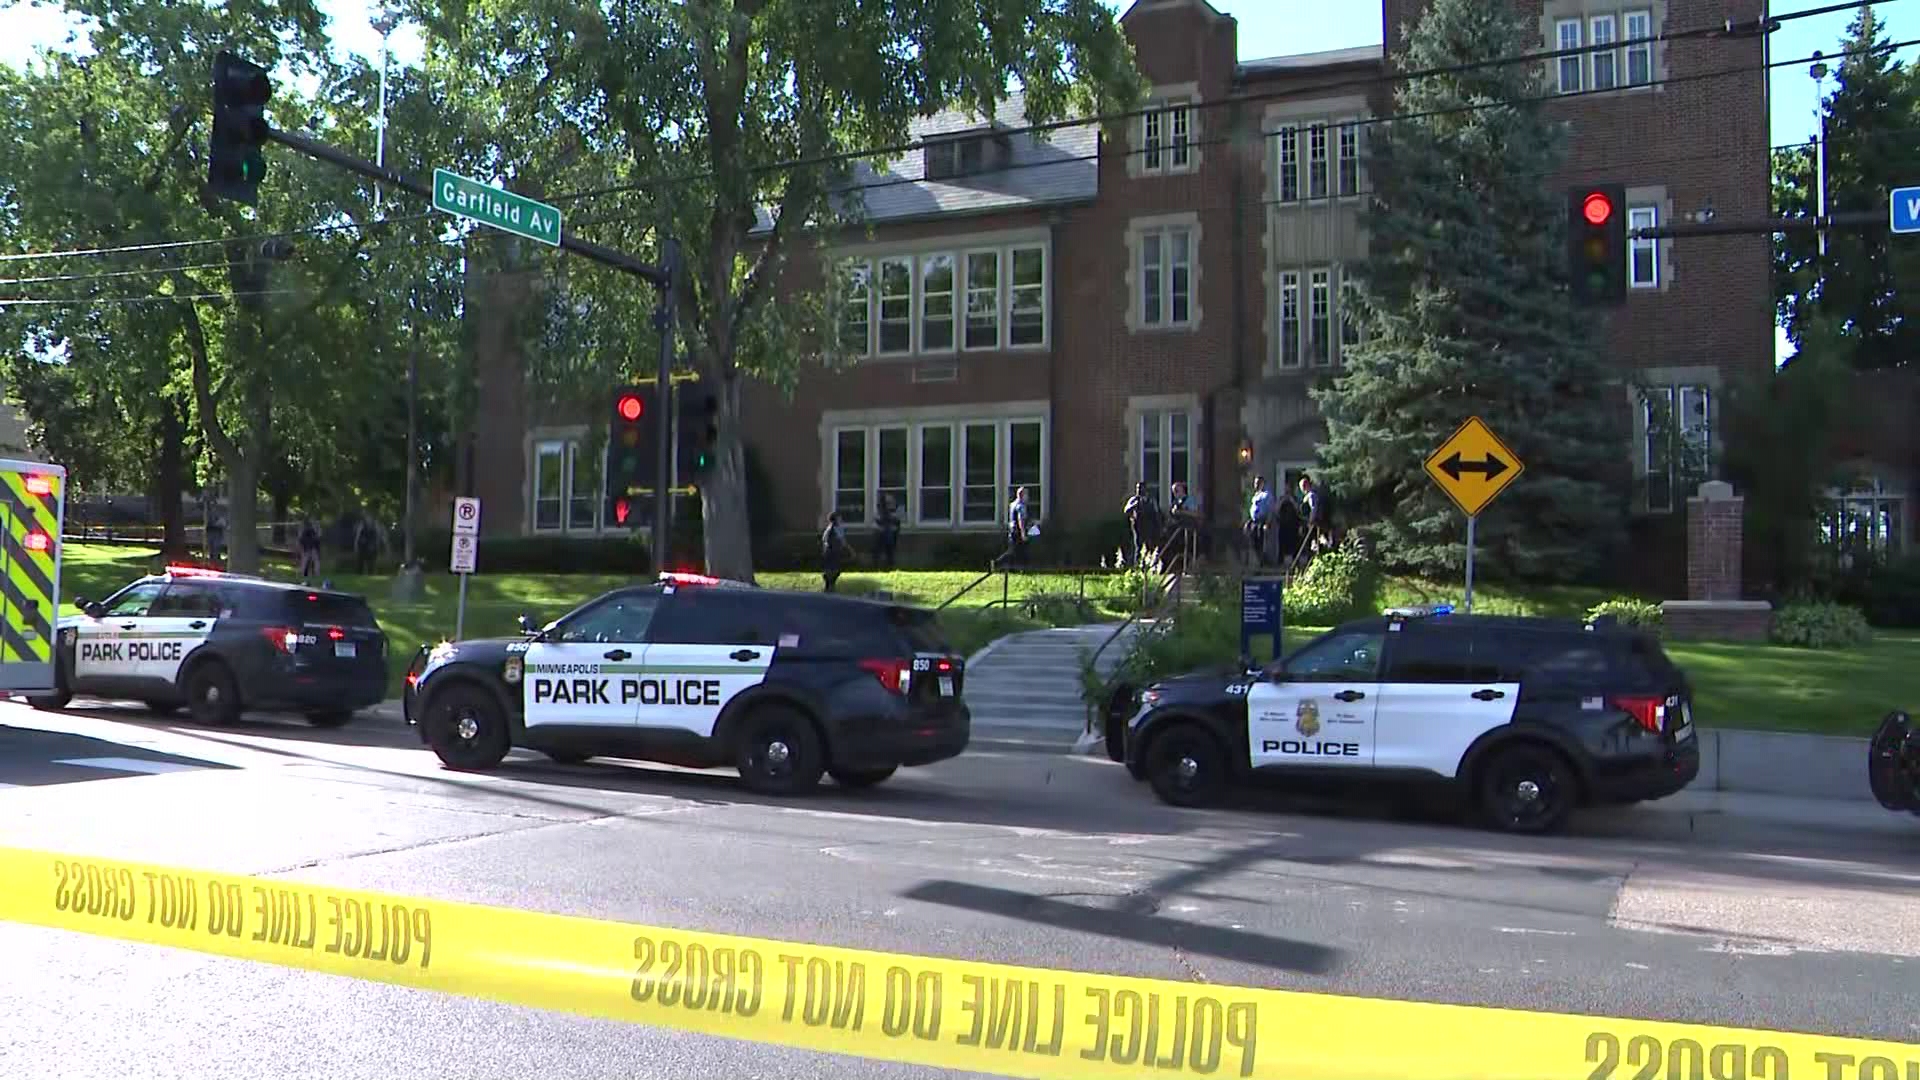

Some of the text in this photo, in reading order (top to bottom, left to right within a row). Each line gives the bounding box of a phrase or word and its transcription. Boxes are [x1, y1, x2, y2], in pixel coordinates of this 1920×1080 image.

[443, 182, 553, 233] Garfield Av
[82, 642, 182, 661] PARK POLICE
[536, 664, 598, 674] MINNEAPOLIS
[913, 659, 930, 671] 850
[535, 679, 720, 705] PARK POLICE
[1225, 684, 1249, 695] 431
[1263, 740, 1359, 756] POLICE
